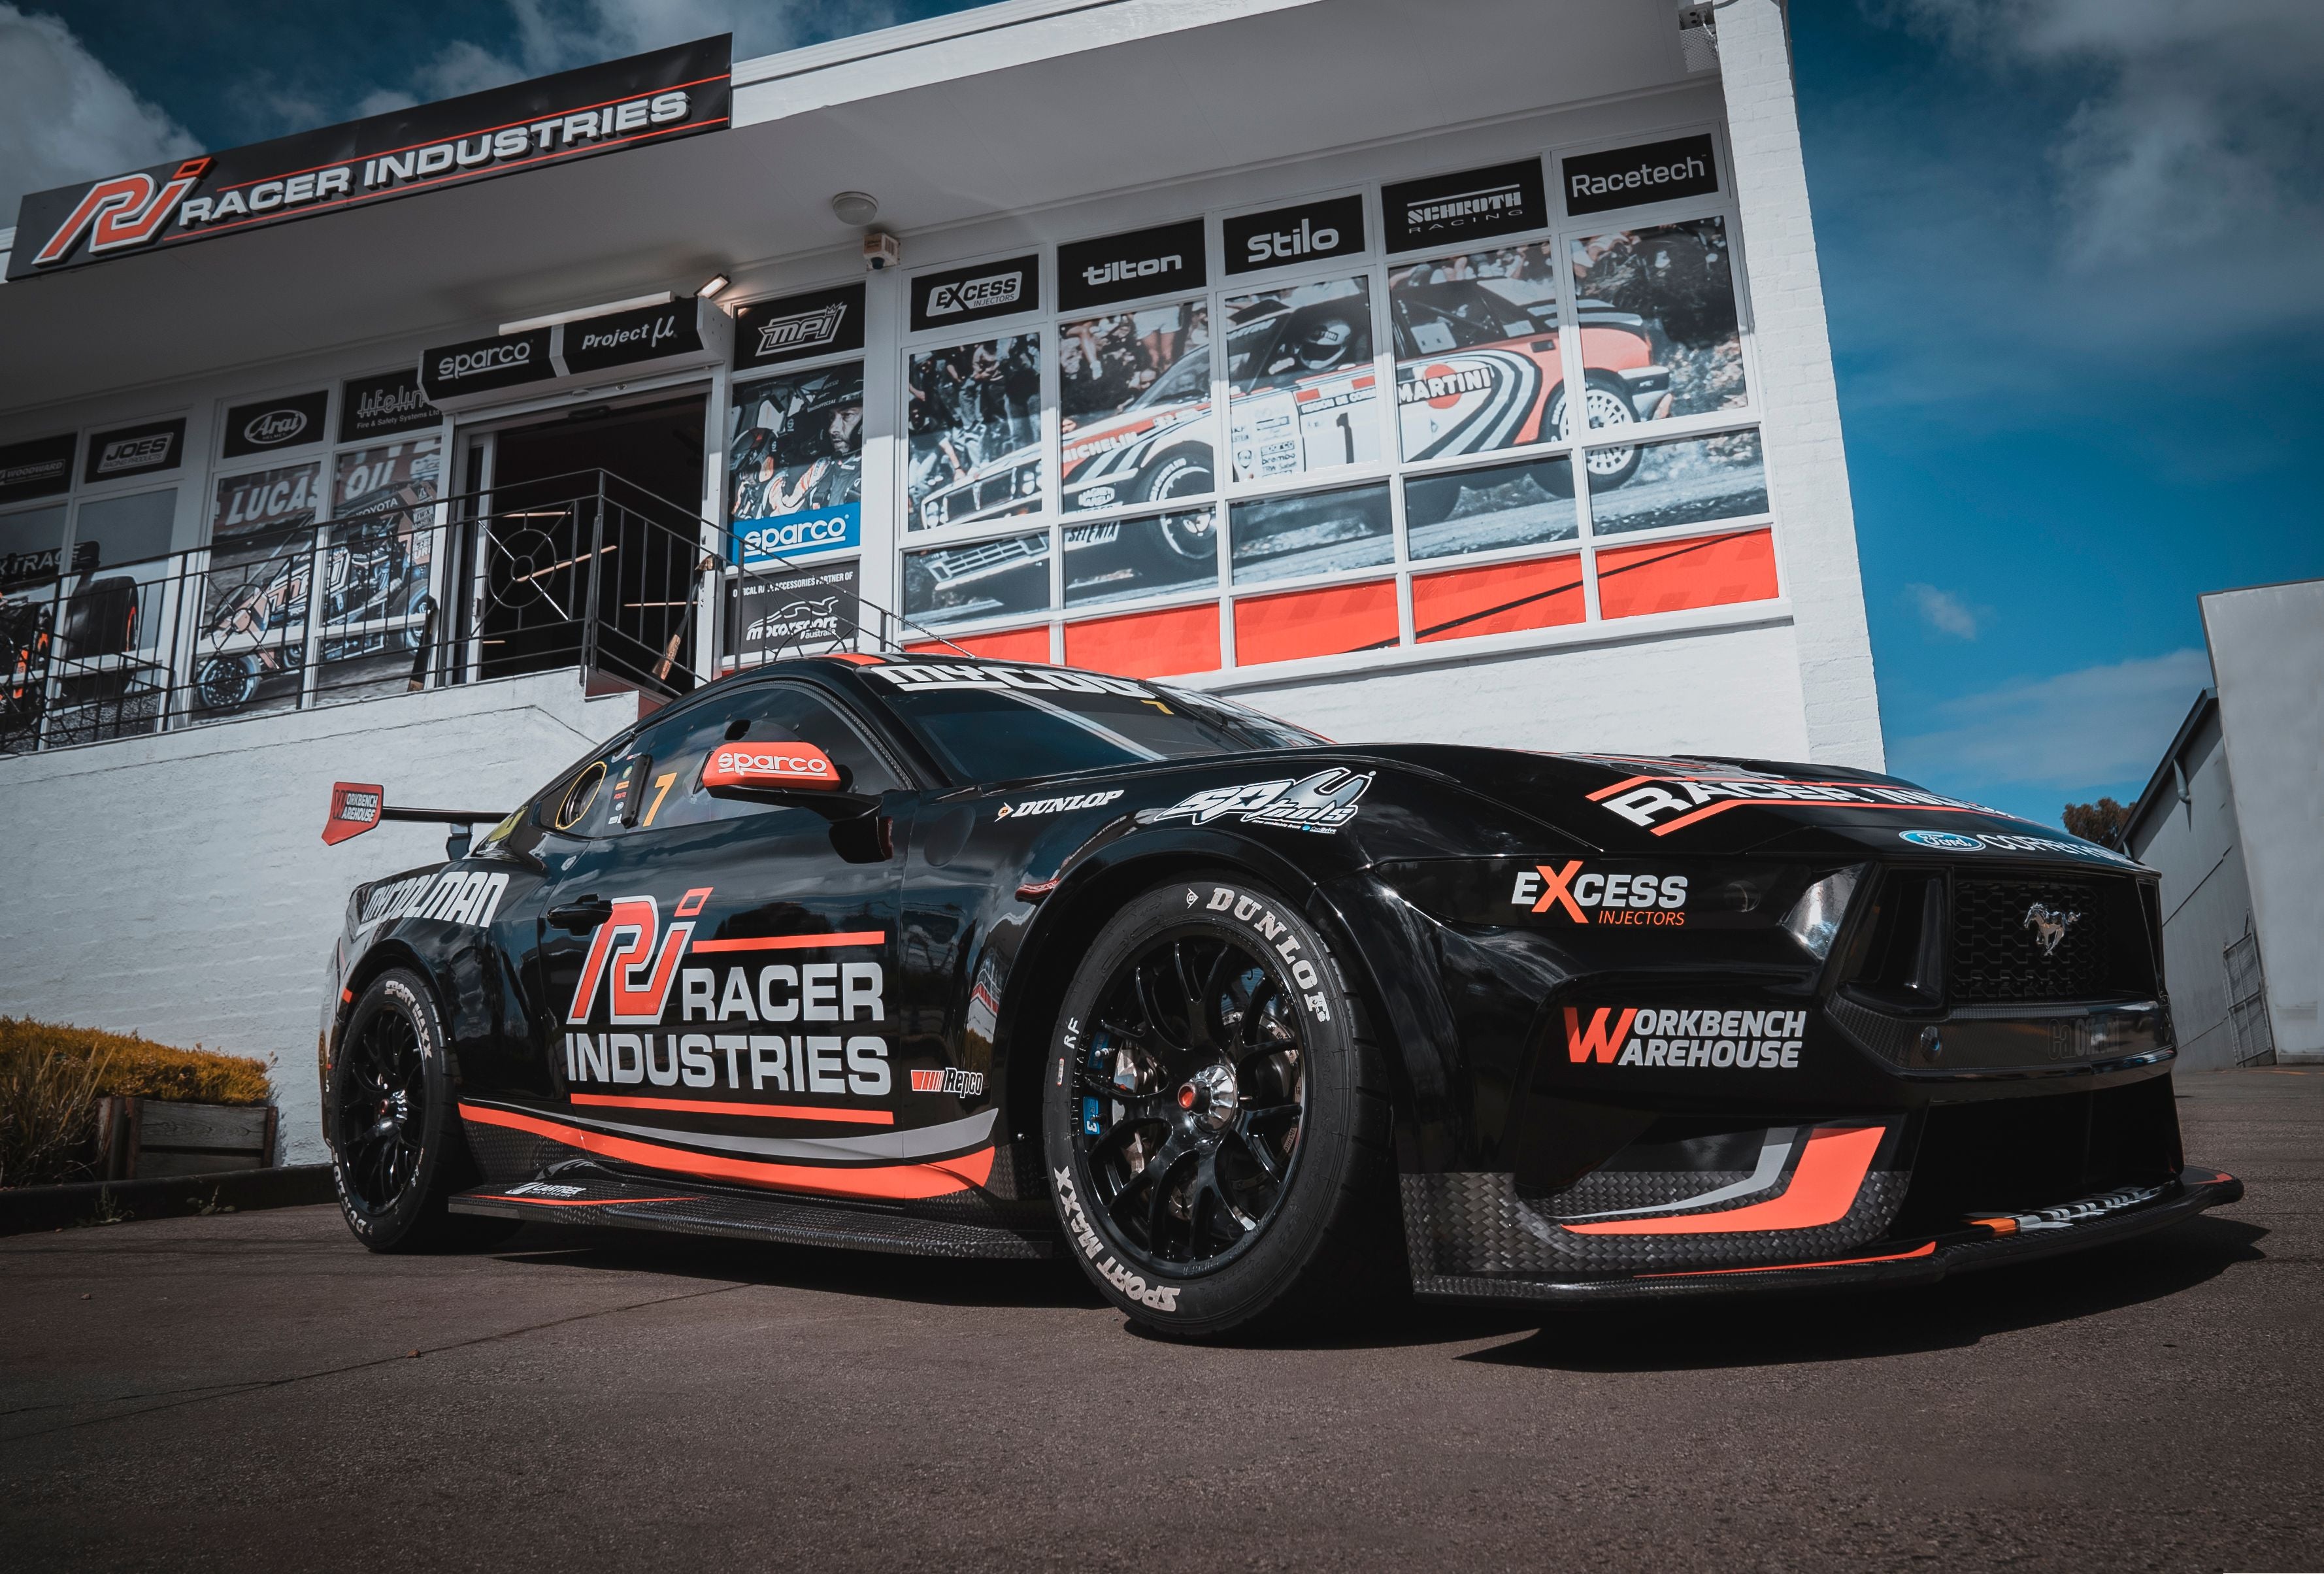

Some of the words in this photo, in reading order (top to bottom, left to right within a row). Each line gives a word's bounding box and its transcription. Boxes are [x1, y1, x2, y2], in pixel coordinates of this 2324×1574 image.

[178, 165, 353, 227] RACER
[364, 91, 691, 189] INDUSTRIES
[1572, 155, 1706, 198] Racetech
[1407, 191, 1522, 225] SCHROTH
[1408, 207, 1523, 234] RACING
[1247, 218, 1340, 263] Stilo
[1082, 254, 1182, 286] tilton
[935, 276, 1017, 311] EXCESS
[973, 292, 1015, 308] INJECTORS
[582, 324, 650, 350] Project
[438, 339, 531, 379] sparco
[357, 384, 426, 419] lifelin
[1399, 367, 1491, 404] MARTINI
[250, 409, 299, 436] Arai
[378, 416, 398, 426] Safety
[399, 410, 427, 422] Systems
[106, 437, 167, 461] JOES
[1336, 412, 1354, 463] 1
[7, 461, 63, 478] WOODWARD
[744, 516, 846, 556] sparco
[845, 571, 854, 581] OF
[718, 752, 827, 776] sparco
[642, 773, 677, 827] 7
[1011, 790, 1123, 818] DUNLOP
[1602, 779, 1876, 826] RACER
[1921, 832, 1972, 847] Ford
[1512, 861, 1687, 924] EXCESS
[1597, 909, 1685, 926] INJECTORS
[1206, 886, 1331, 1023] DUNLOP
[682, 962, 885, 1021] RACER
[1063, 1016, 1080, 1049] RF
[565, 1033, 891, 1096] INDUSTRIES
[943, 1067, 983, 1099] Repco
[1053, 1165, 1104, 1260] MAXX
[1095, 1255, 1181, 1313] SPORT
